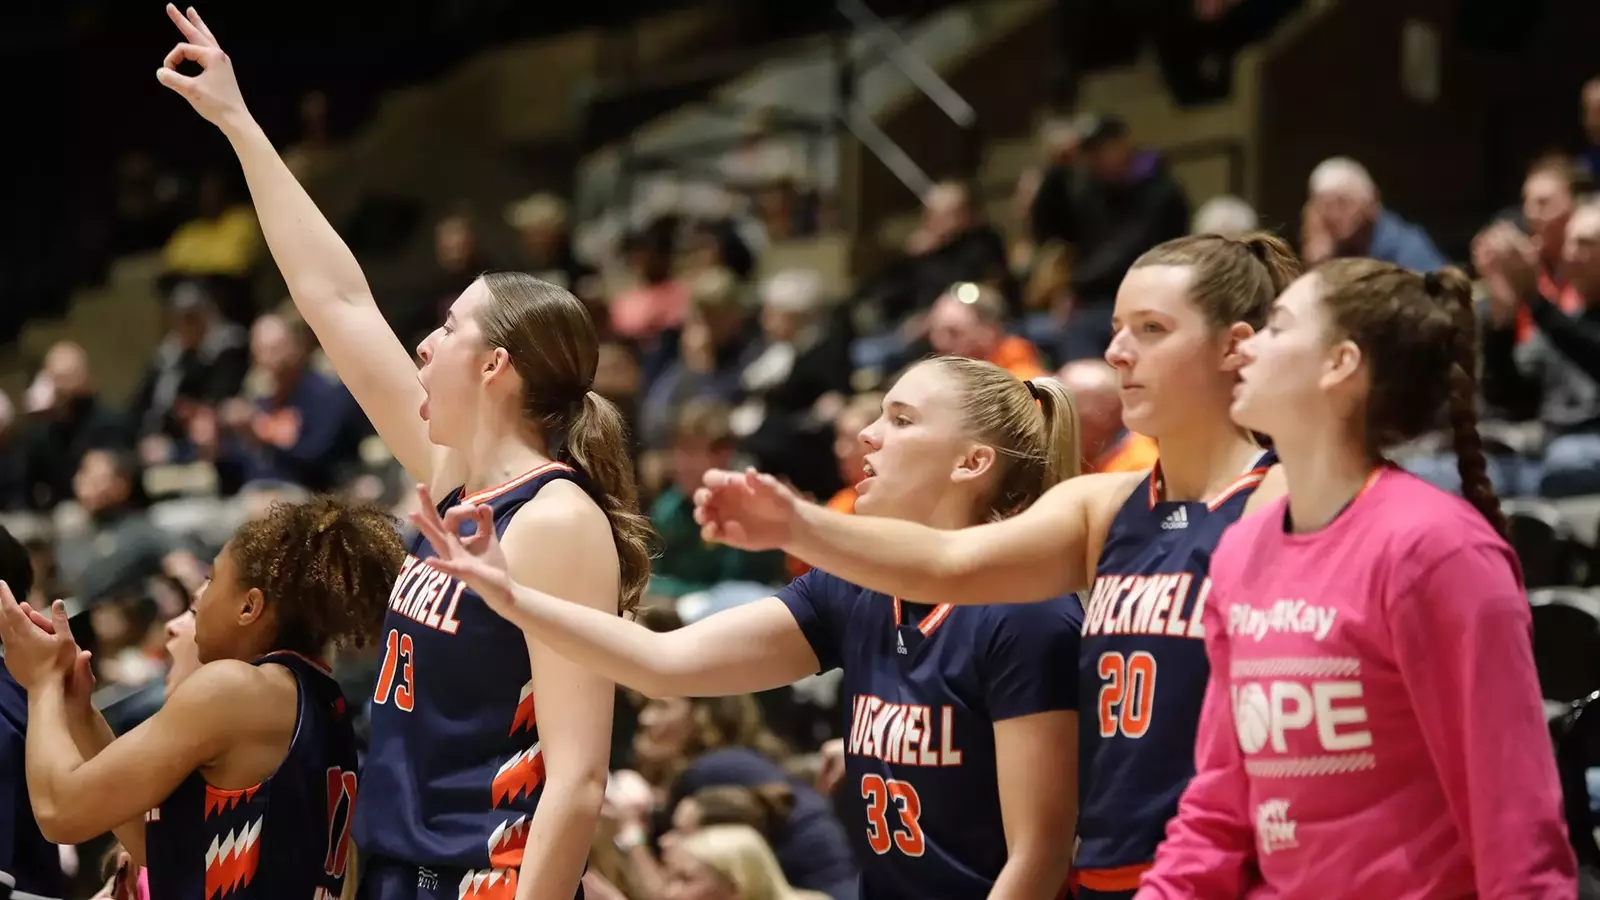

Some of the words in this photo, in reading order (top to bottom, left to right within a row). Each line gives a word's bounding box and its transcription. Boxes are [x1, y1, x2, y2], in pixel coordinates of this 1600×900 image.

[388, 553, 467, 635] UCKNELL
[373, 628, 415, 712] 13
[1098, 651, 1157, 739] 20
[848, 693, 963, 766] UCKNELL
[1231, 680, 1373, 755] OPE
[861, 773, 926, 857] 33
